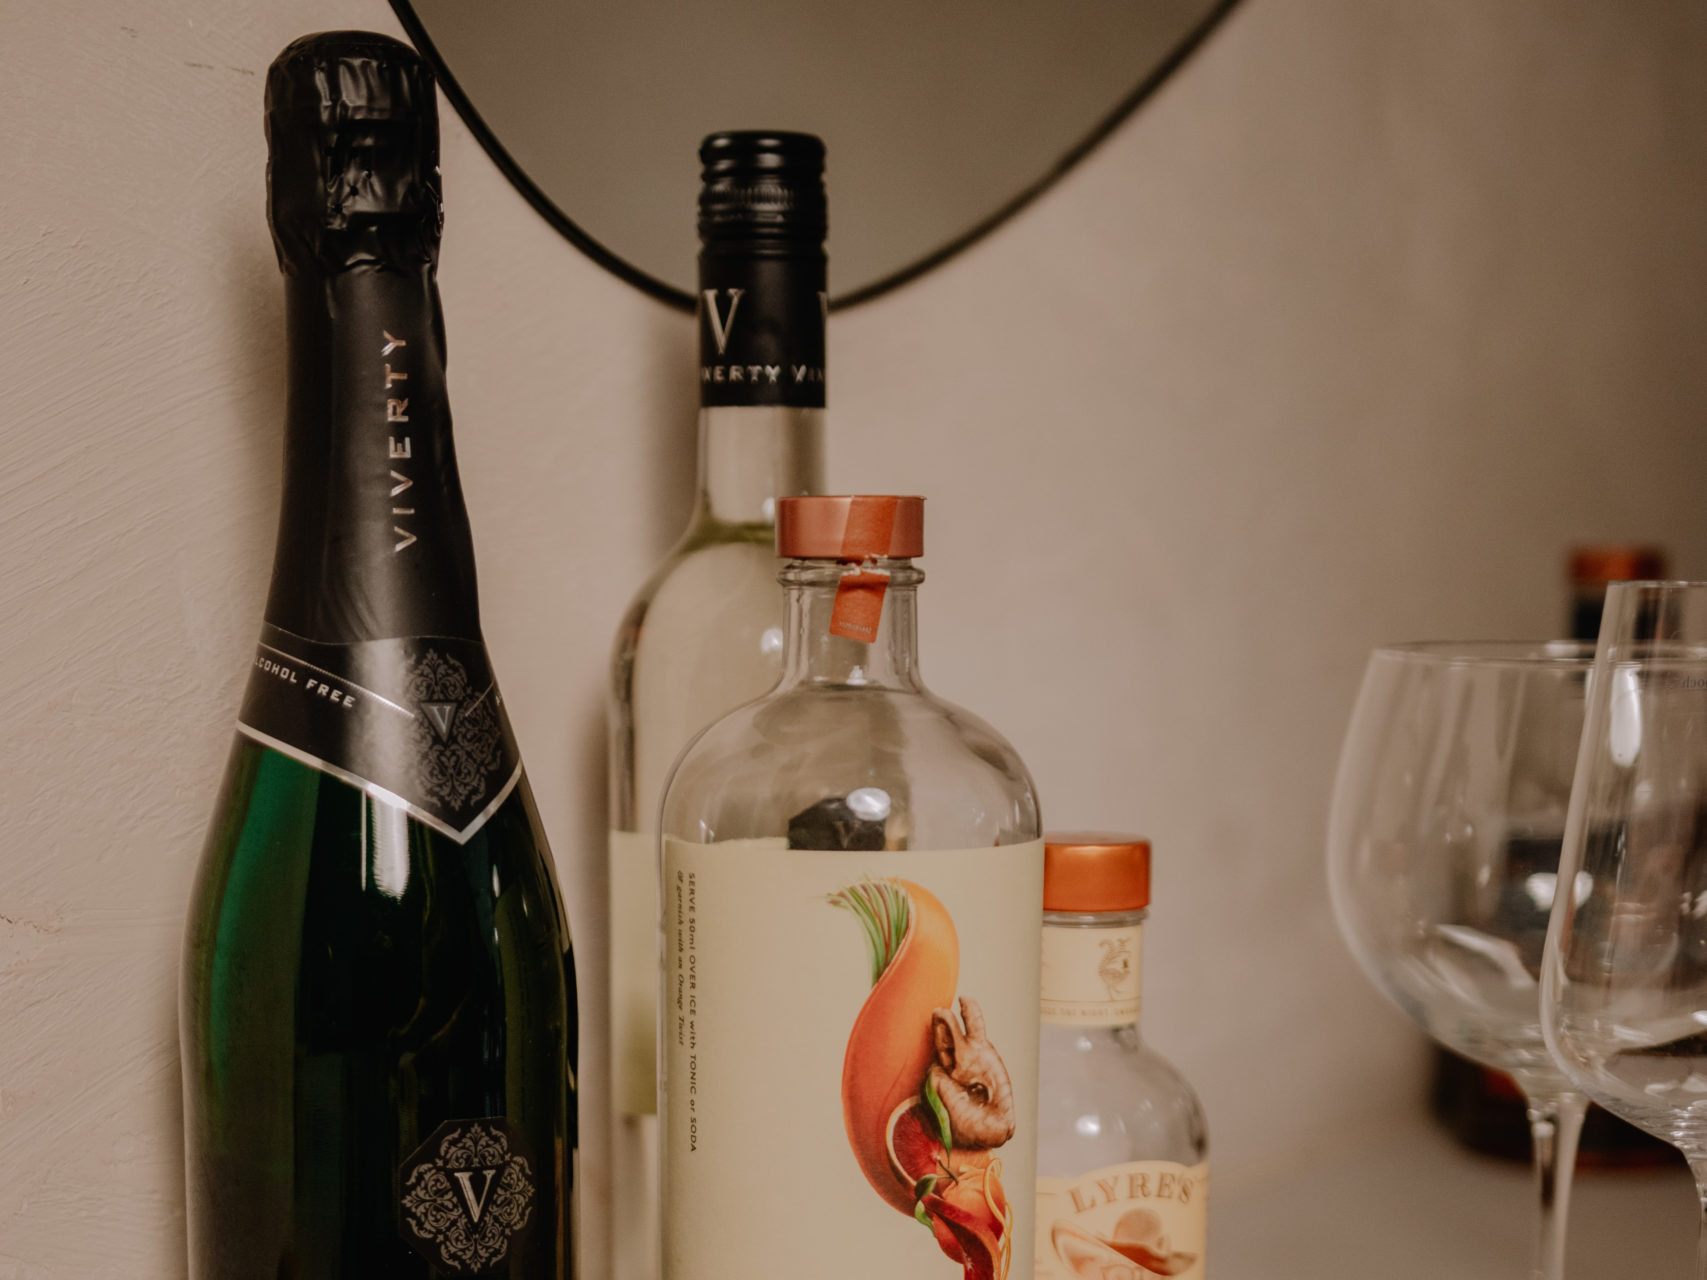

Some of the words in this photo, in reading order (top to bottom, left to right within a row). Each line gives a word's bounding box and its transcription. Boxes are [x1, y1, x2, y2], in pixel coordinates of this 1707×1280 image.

[703, 288, 746, 355] V
[381, 329, 417, 553] VIVERTY
[306, 678, 356, 708] FREE
[430, 705, 451, 735] V
[690, 1099, 696, 1112] or
[454, 1169, 496, 1223] V
